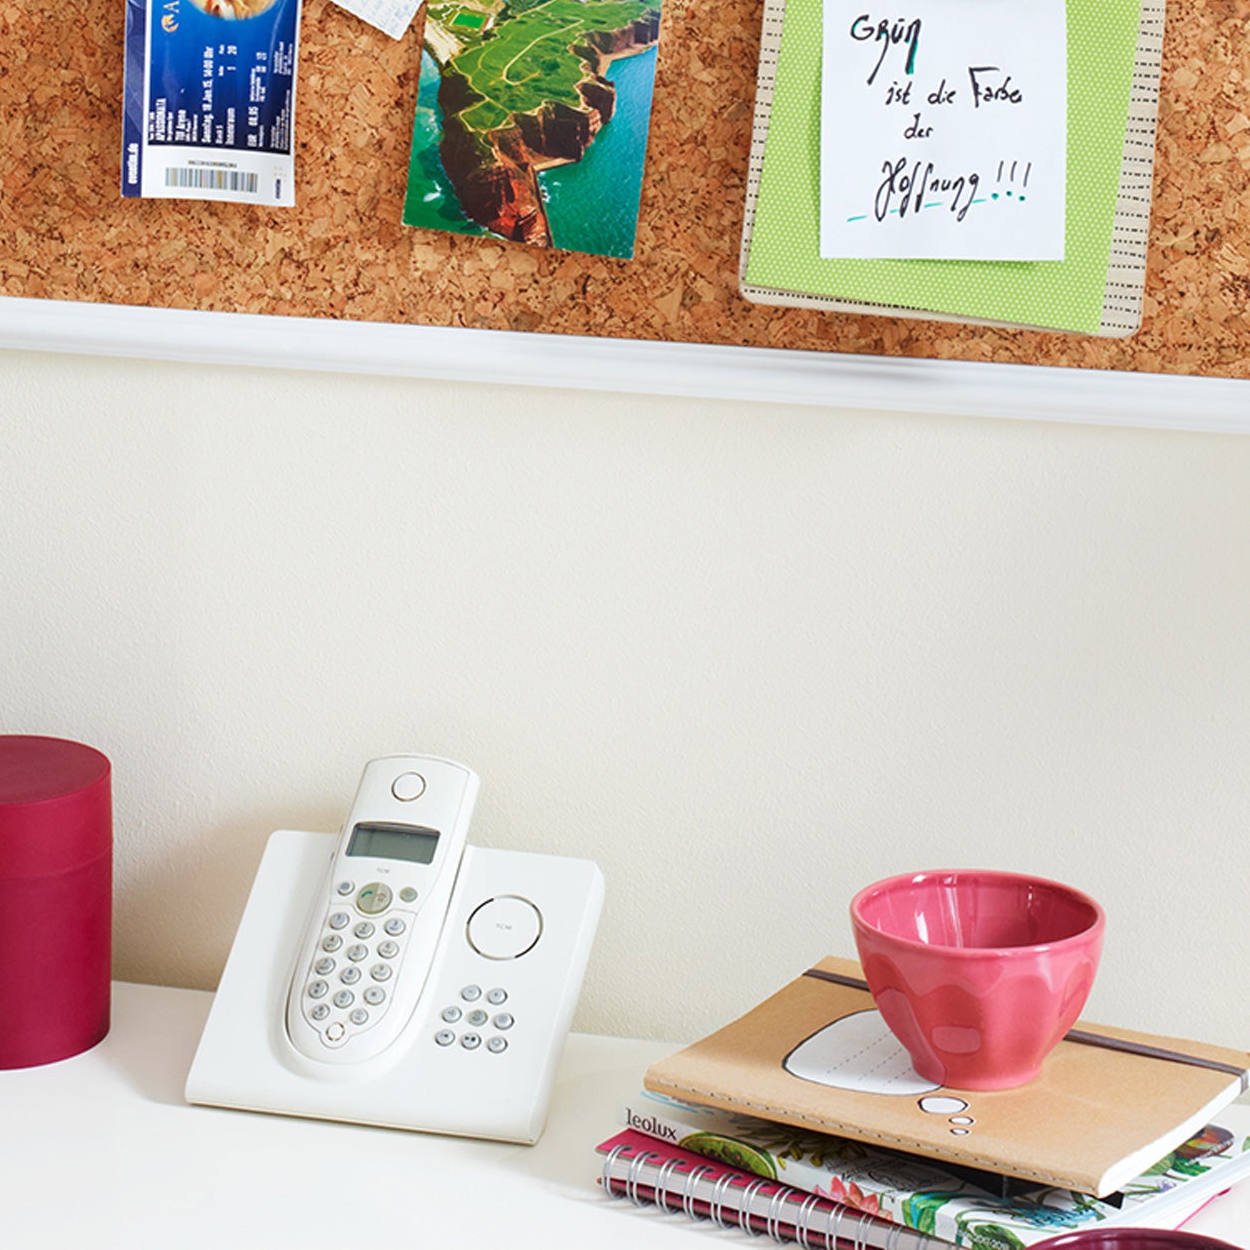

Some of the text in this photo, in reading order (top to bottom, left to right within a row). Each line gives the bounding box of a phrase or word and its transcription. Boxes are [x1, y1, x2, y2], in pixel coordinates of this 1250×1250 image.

[885, 66, 1023, 108] ist die Farbe
[903, 112, 934, 139] der
[874, 156, 980, 222] Hoffnung
[625, 1107, 678, 1141] leolux
